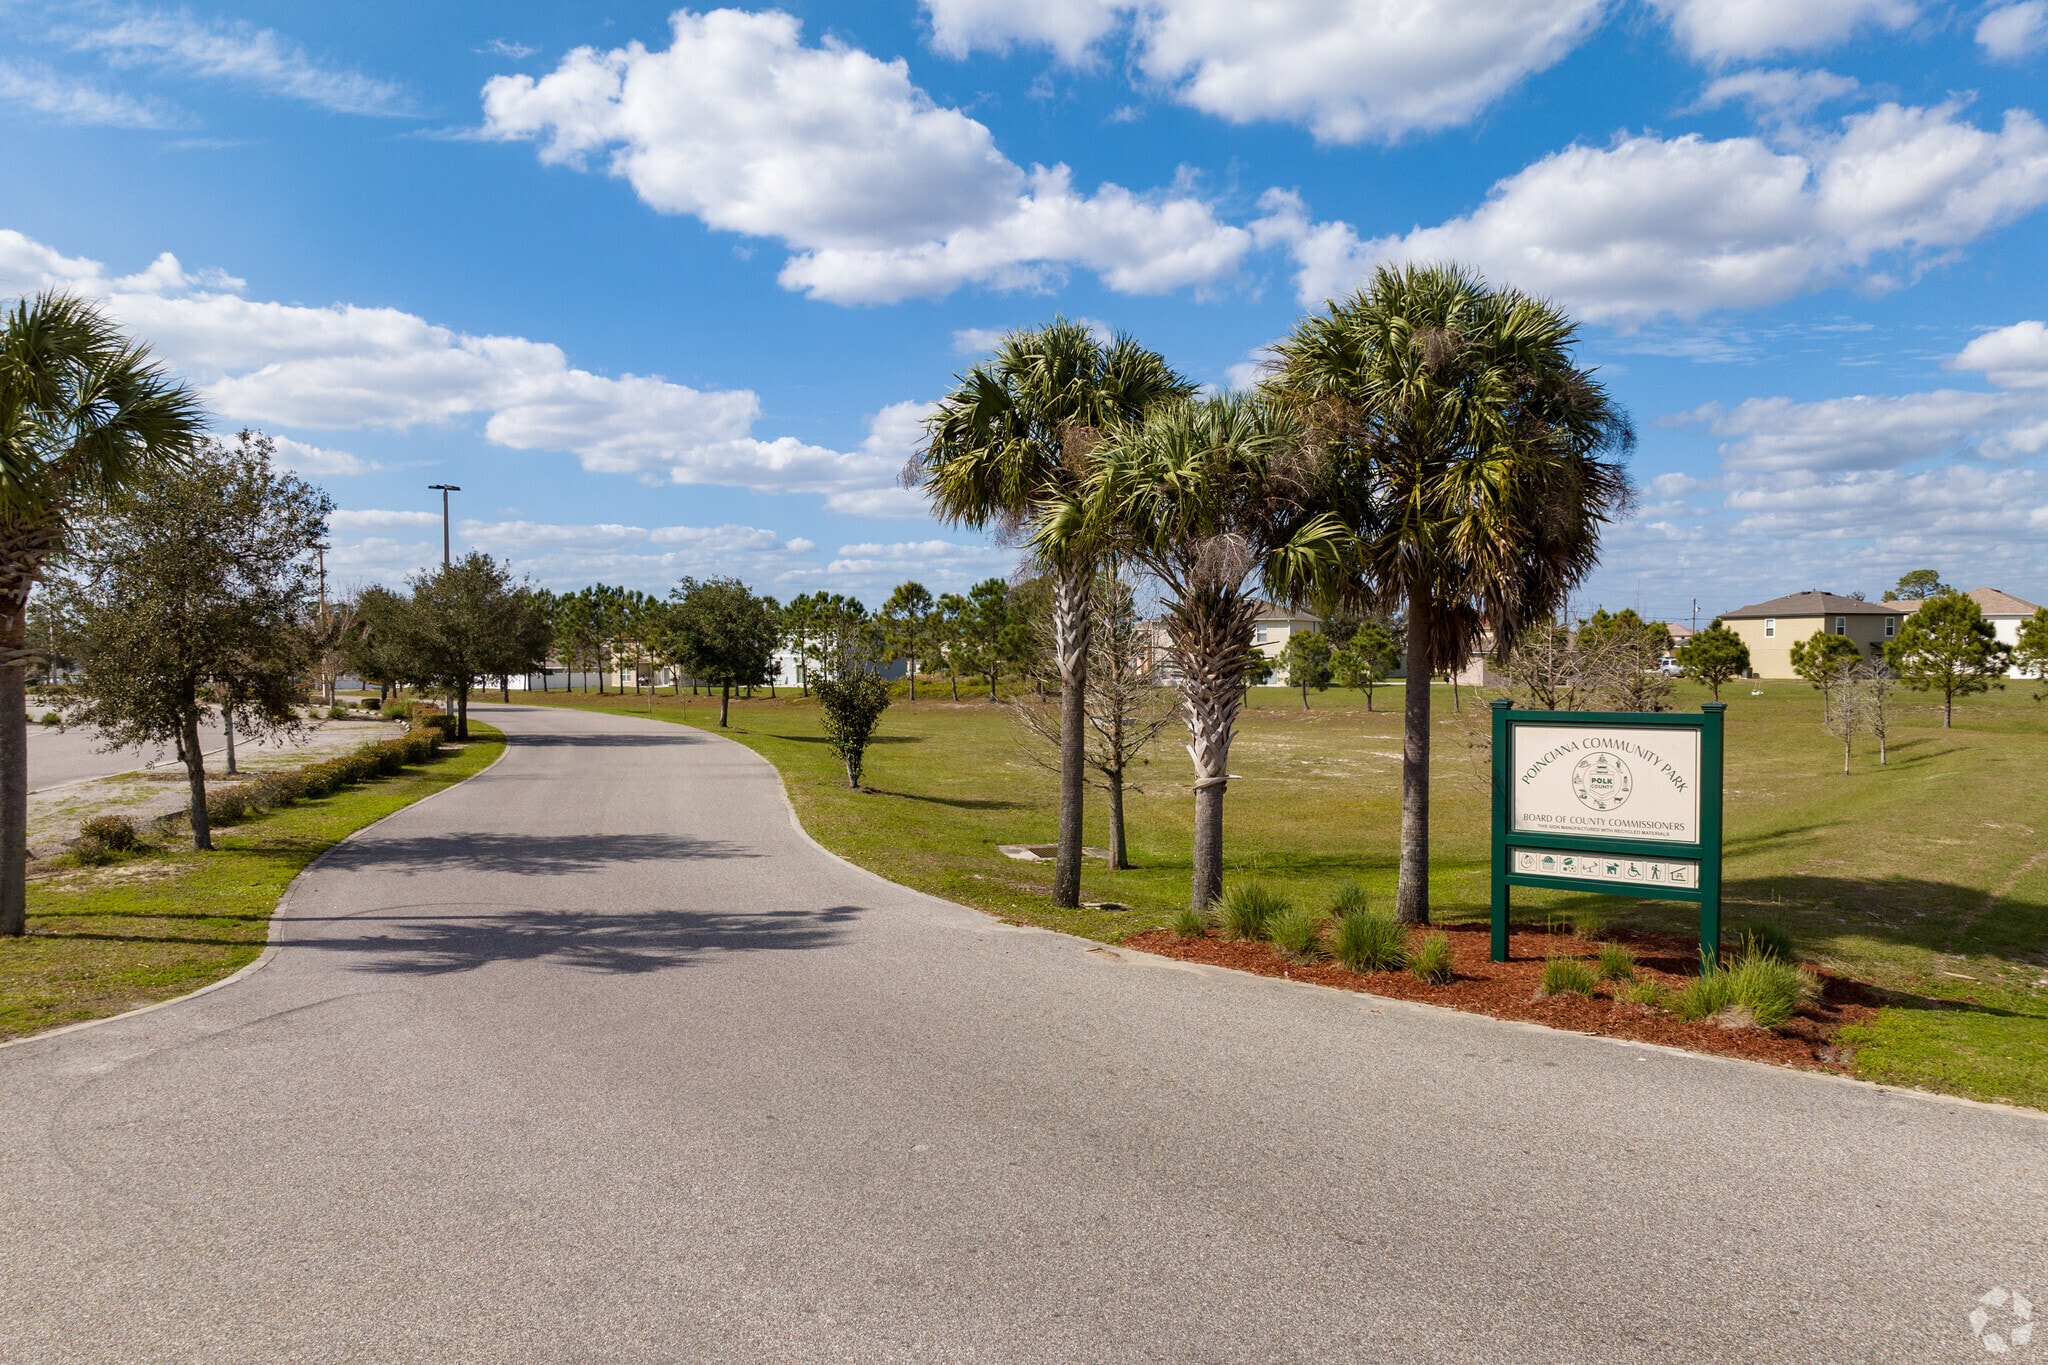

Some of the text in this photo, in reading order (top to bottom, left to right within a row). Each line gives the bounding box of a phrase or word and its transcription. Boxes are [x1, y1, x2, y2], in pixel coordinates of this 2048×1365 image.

[1521, 737, 1689, 793] POINCIANA COMMUNITY PARK
[1523, 813, 1686, 831] BOARD OF COUNTY COMMISSIONERS
